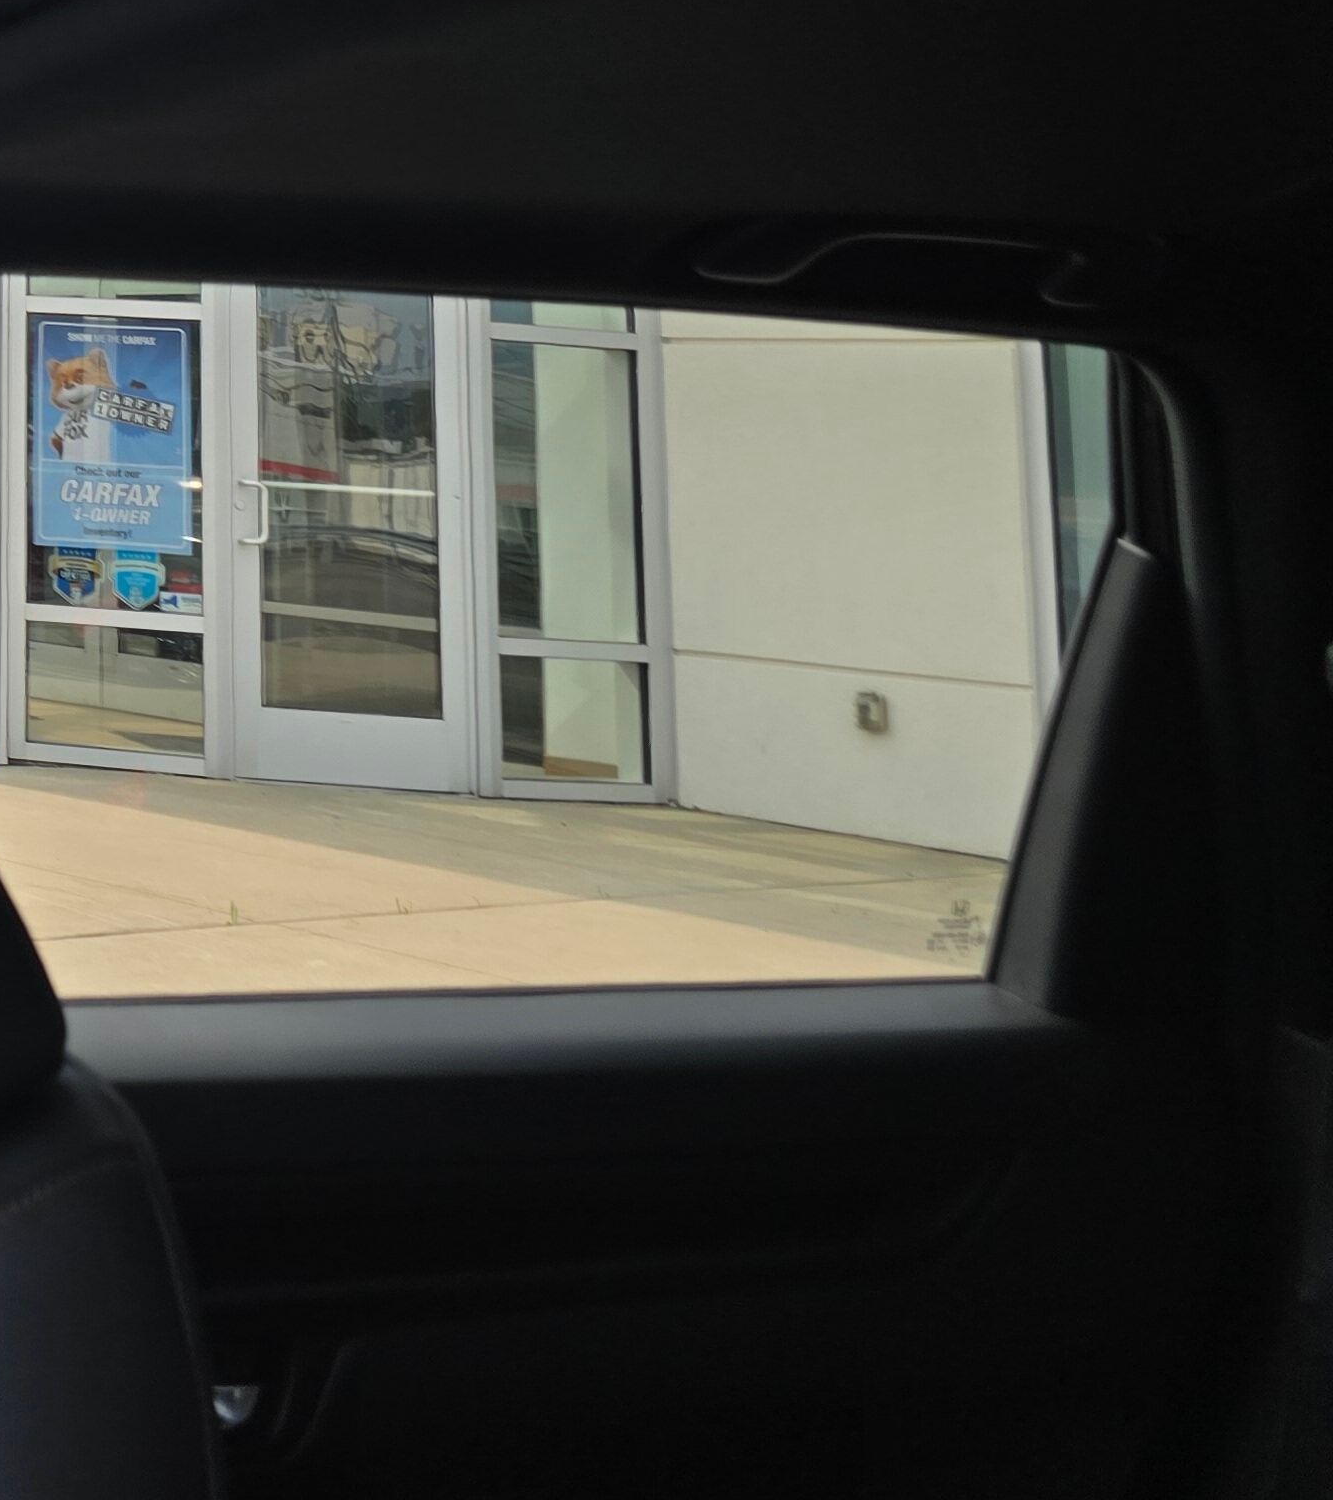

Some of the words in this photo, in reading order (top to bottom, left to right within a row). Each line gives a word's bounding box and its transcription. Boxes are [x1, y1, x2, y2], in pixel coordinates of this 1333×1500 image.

[108, 408, 170, 431] OWNER
[61, 479, 162, 508] CARFAX
[72, 507, 151, 525] 1-OWNER
